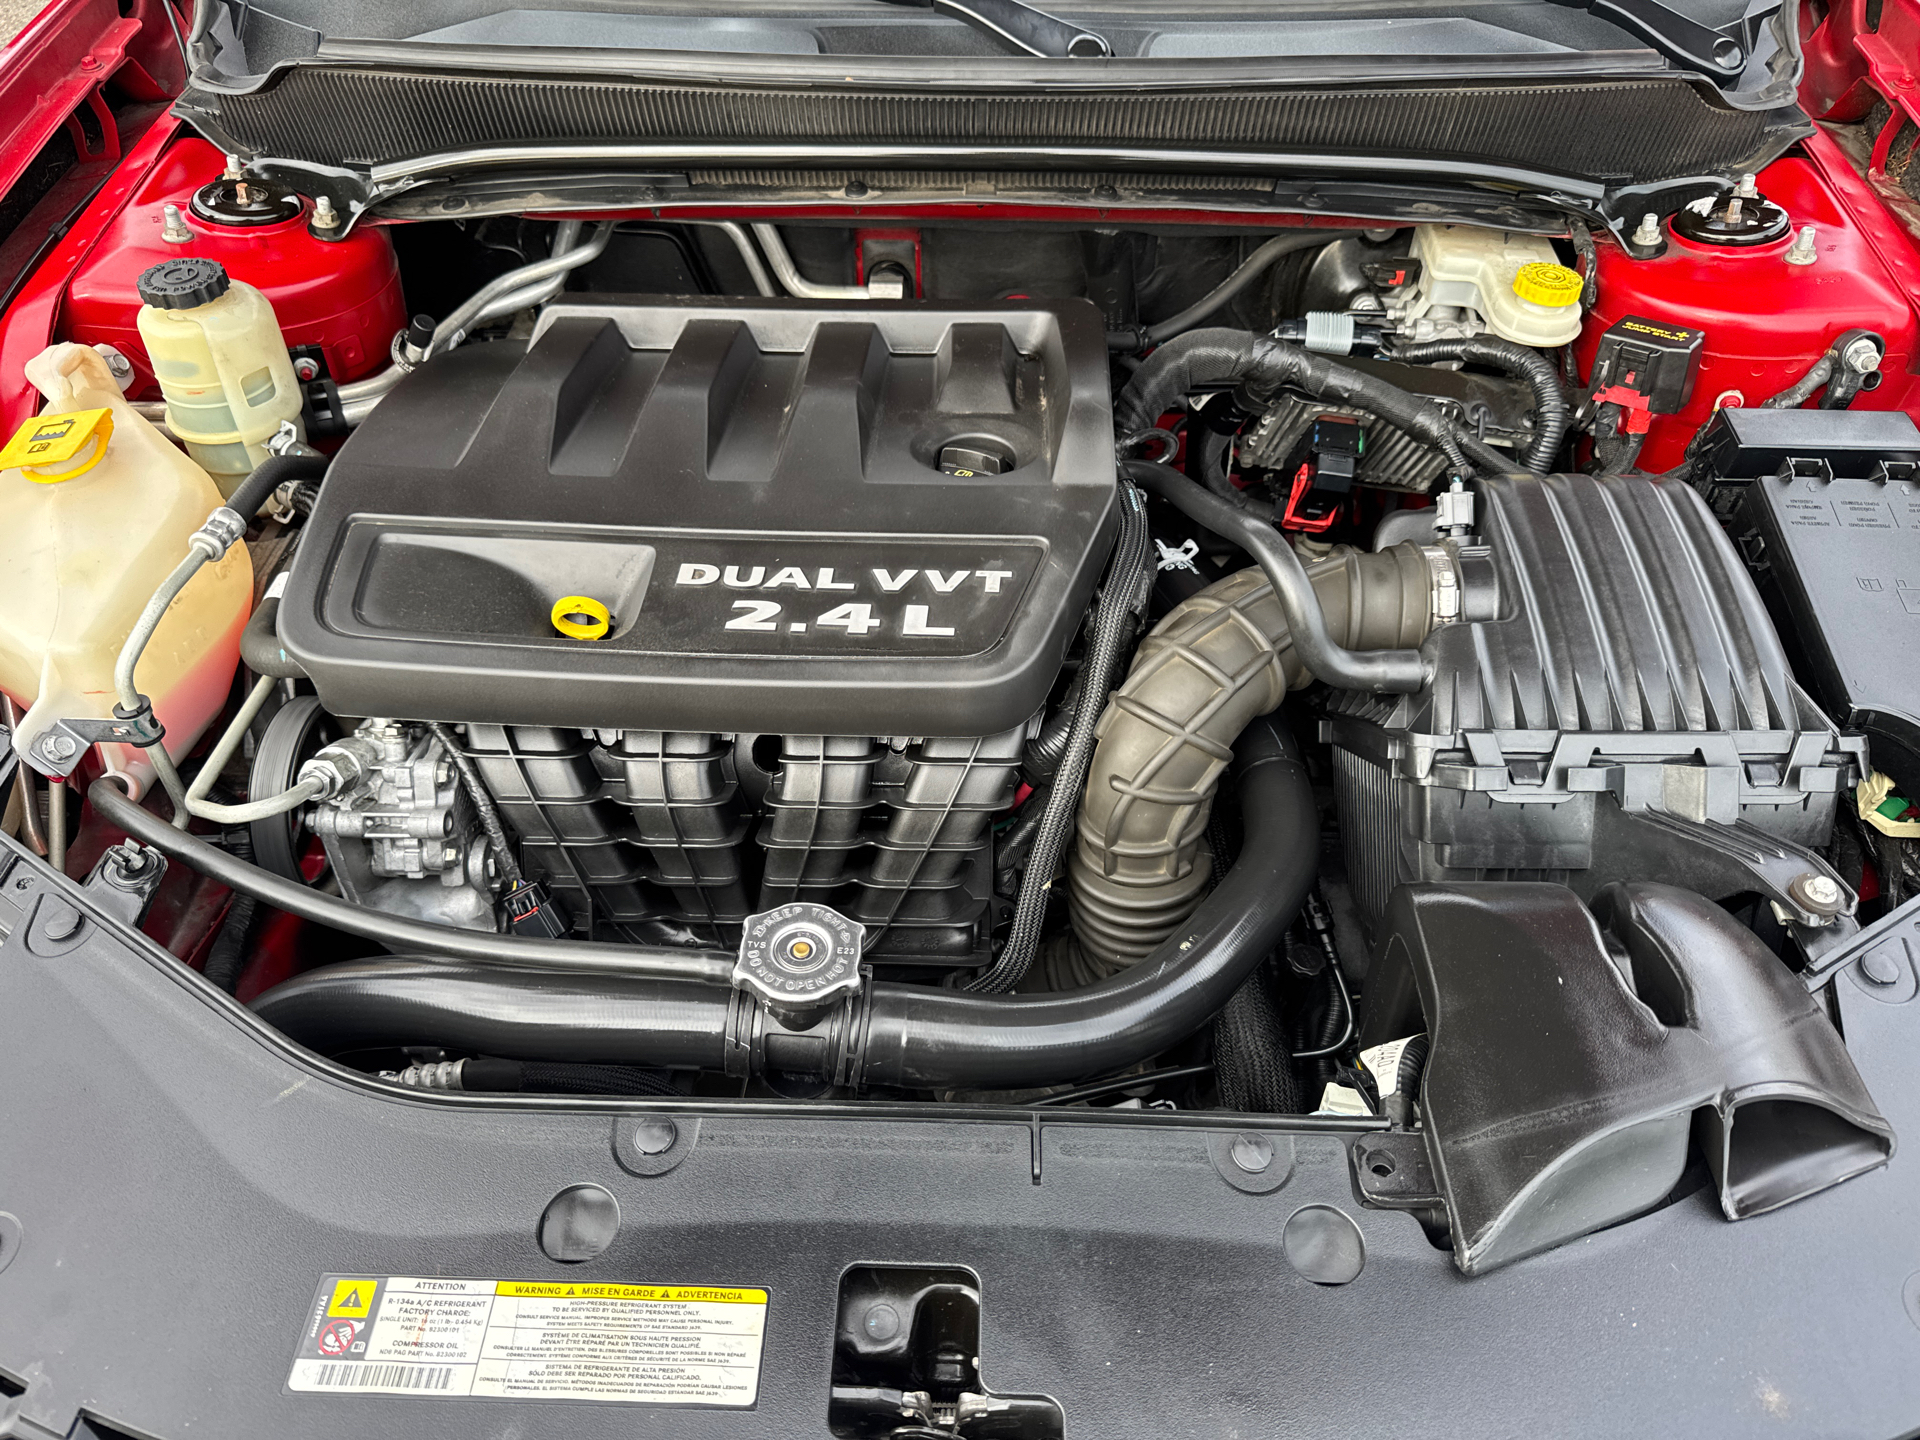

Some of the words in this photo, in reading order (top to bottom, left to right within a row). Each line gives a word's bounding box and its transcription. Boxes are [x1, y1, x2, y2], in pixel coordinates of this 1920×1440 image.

[1622, 325, 1651, 334] JUMP
[1652, 332, 1686, 342] START
[1625, 322, 1672, 334] BATTERY
[675, 563, 856, 590] DUAL
[871, 568, 1013, 594] VVT
[724, 600, 881, 634] 2.4
[902, 604, 956, 636] L
[764, 906, 803, 927] KEEP
[812, 907, 848, 932] TIGHT
[748, 940, 766, 949] TVS
[836, 947, 855, 955] E23
[747, 949, 762, 967] DO
[756, 965, 784, 986] NOT
[785, 976, 826, 990] OPEN
[826, 957, 848, 980] HOT
[415, 1281, 466, 1290] ATTENTION
[514, 1286, 561, 1294] WARNING
[622, 1288, 655, 1297] GARDE
[676, 1290, 743, 1299] ADVERTENCIA
[434, 1299, 486, 1307] REFRIGERANT
[398, 1307, 434, 1315] FACTORY
[392, 1340, 444, 1348] COMPRESSOR
